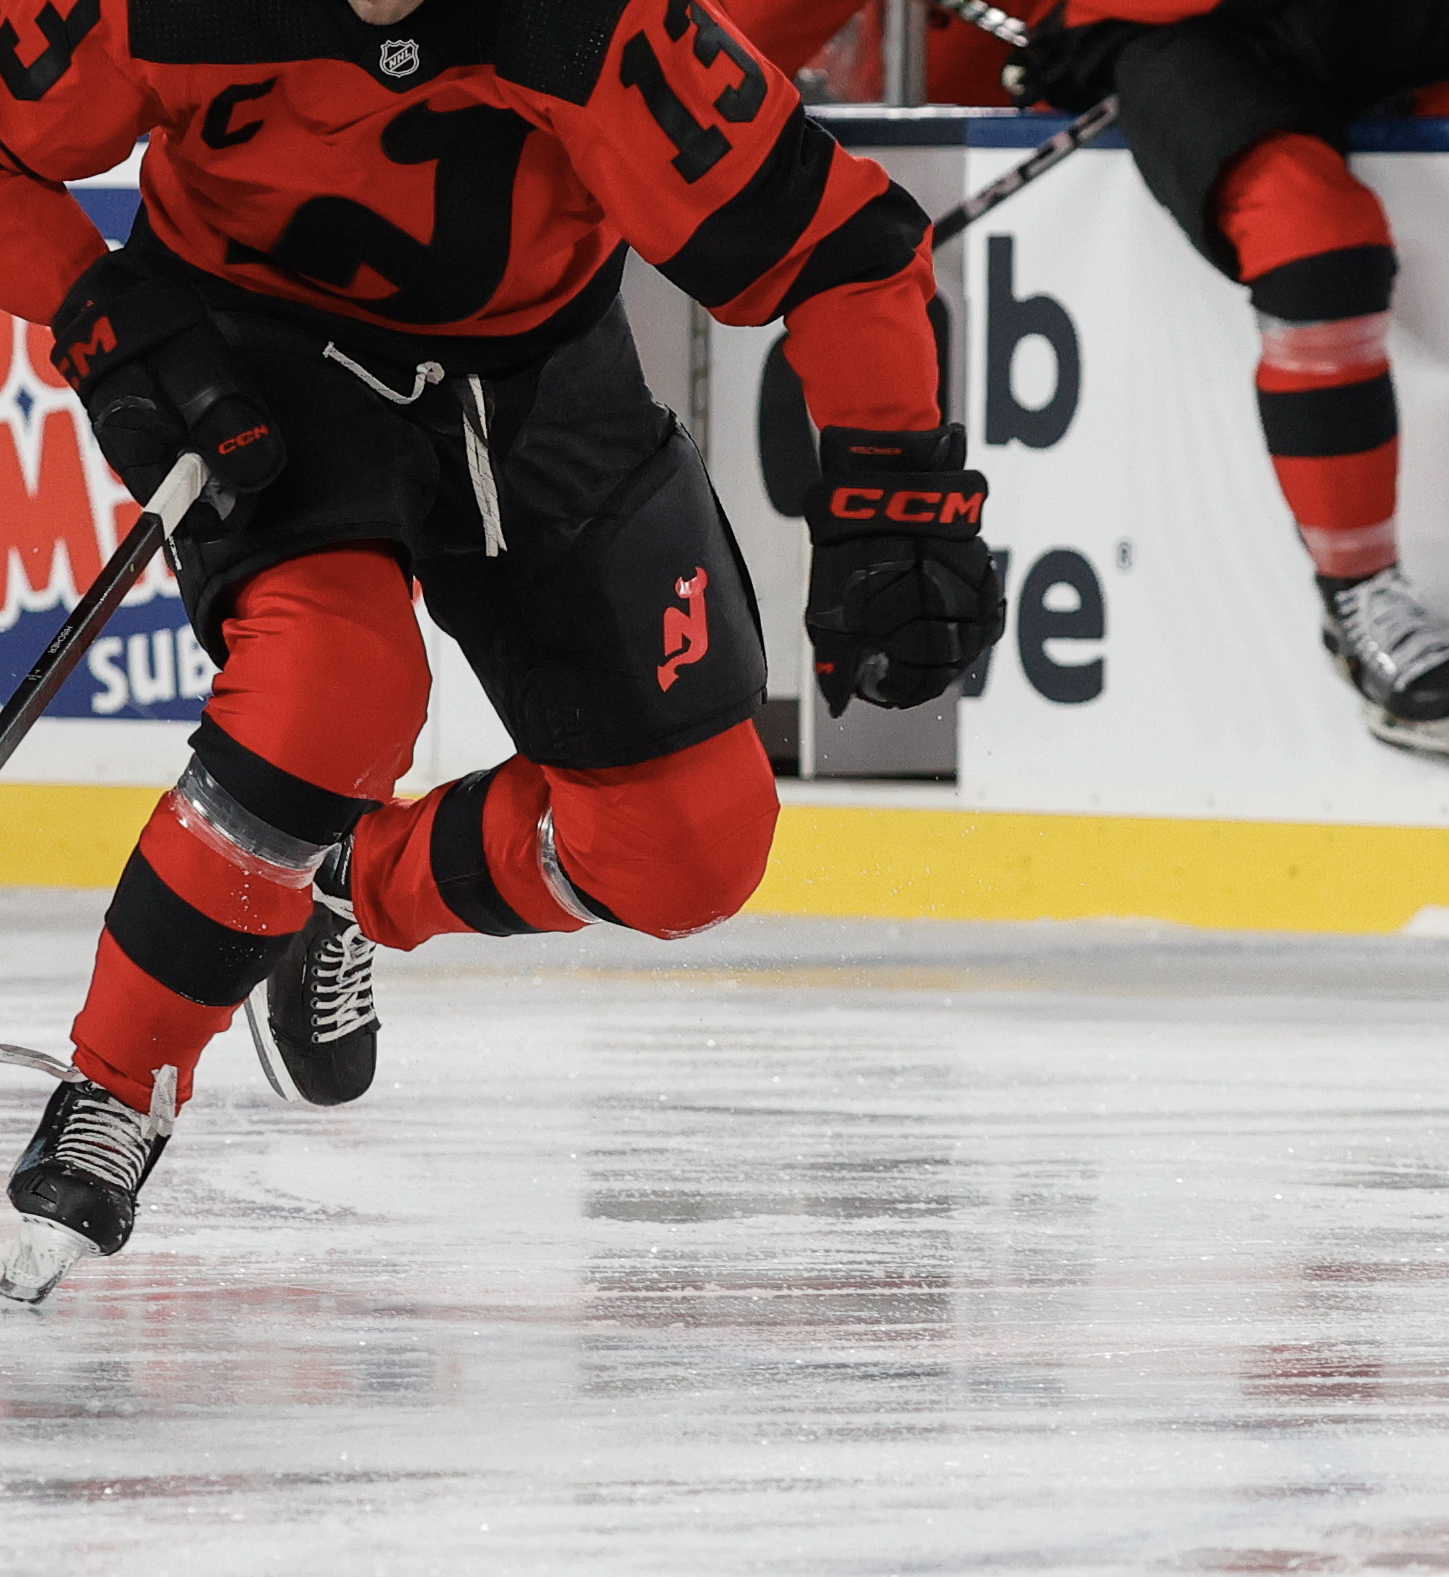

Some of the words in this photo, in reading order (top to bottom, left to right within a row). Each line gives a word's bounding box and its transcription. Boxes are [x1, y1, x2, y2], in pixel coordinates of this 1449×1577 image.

[389, 49, 412, 69] NHL
[201, 78, 275, 150] C
[829, 487, 986, 524] CCM
[87, 623, 223, 715] SUB
